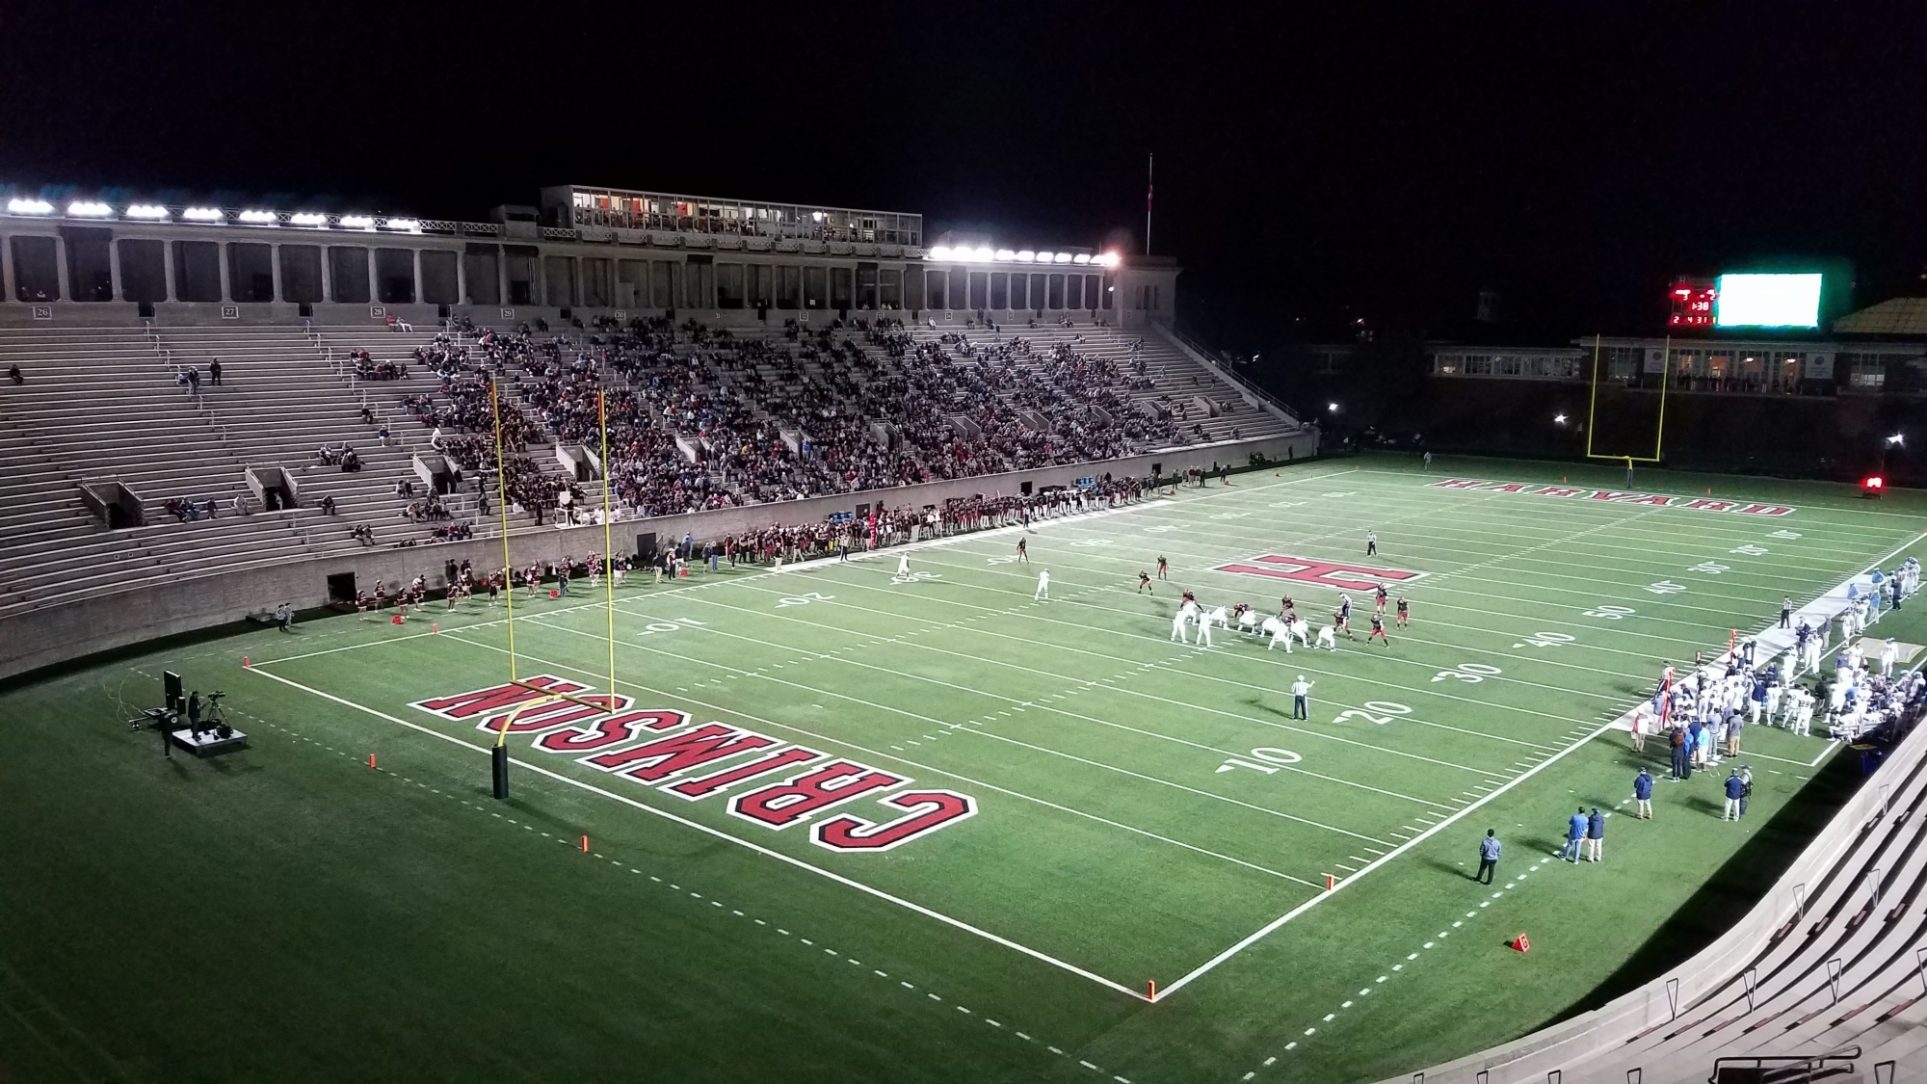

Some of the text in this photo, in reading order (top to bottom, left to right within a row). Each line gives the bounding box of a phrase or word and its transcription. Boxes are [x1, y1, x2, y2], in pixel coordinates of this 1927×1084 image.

[1428, 478, 1796, 516] HARVARD
[1207, 553, 1431, 593] H
[645, 617, 707, 632] 10
[1582, 605, 1636, 620] 50
[1522, 631, 1576, 648] 40
[1437, 663, 1503, 683] 30
[1340, 701, 1413, 725] 20
[406, 673, 978, 852] CRIMSON
[1223, 747, 1303, 775] 10
